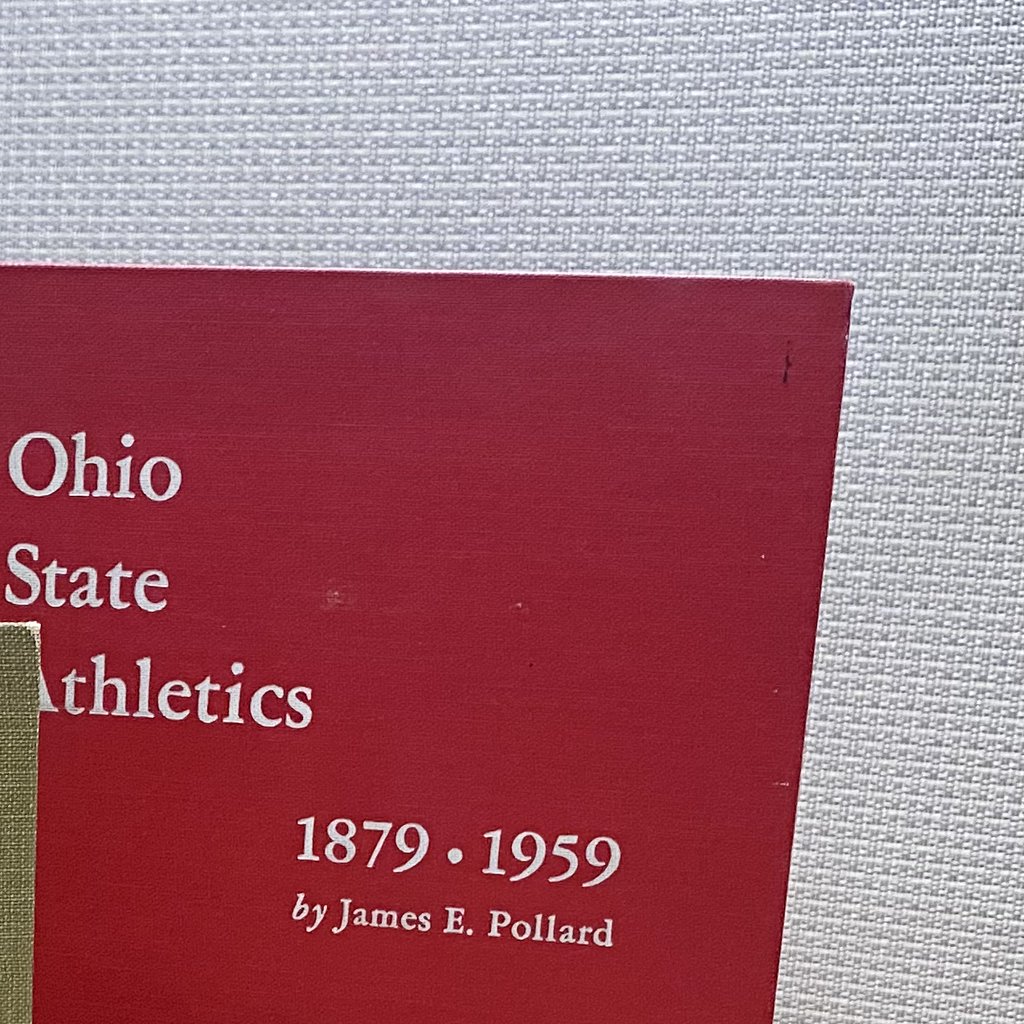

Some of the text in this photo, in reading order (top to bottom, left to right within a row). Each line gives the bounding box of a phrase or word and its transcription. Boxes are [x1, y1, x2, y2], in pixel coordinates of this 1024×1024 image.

[8, 431, 182, 501] Ohio
[4, 543, 169, 612] State
[296, 816, 430, 873] 1879
[482, 829, 622, 887] 1959
[292, 892, 614, 947] by James E. Pollard
